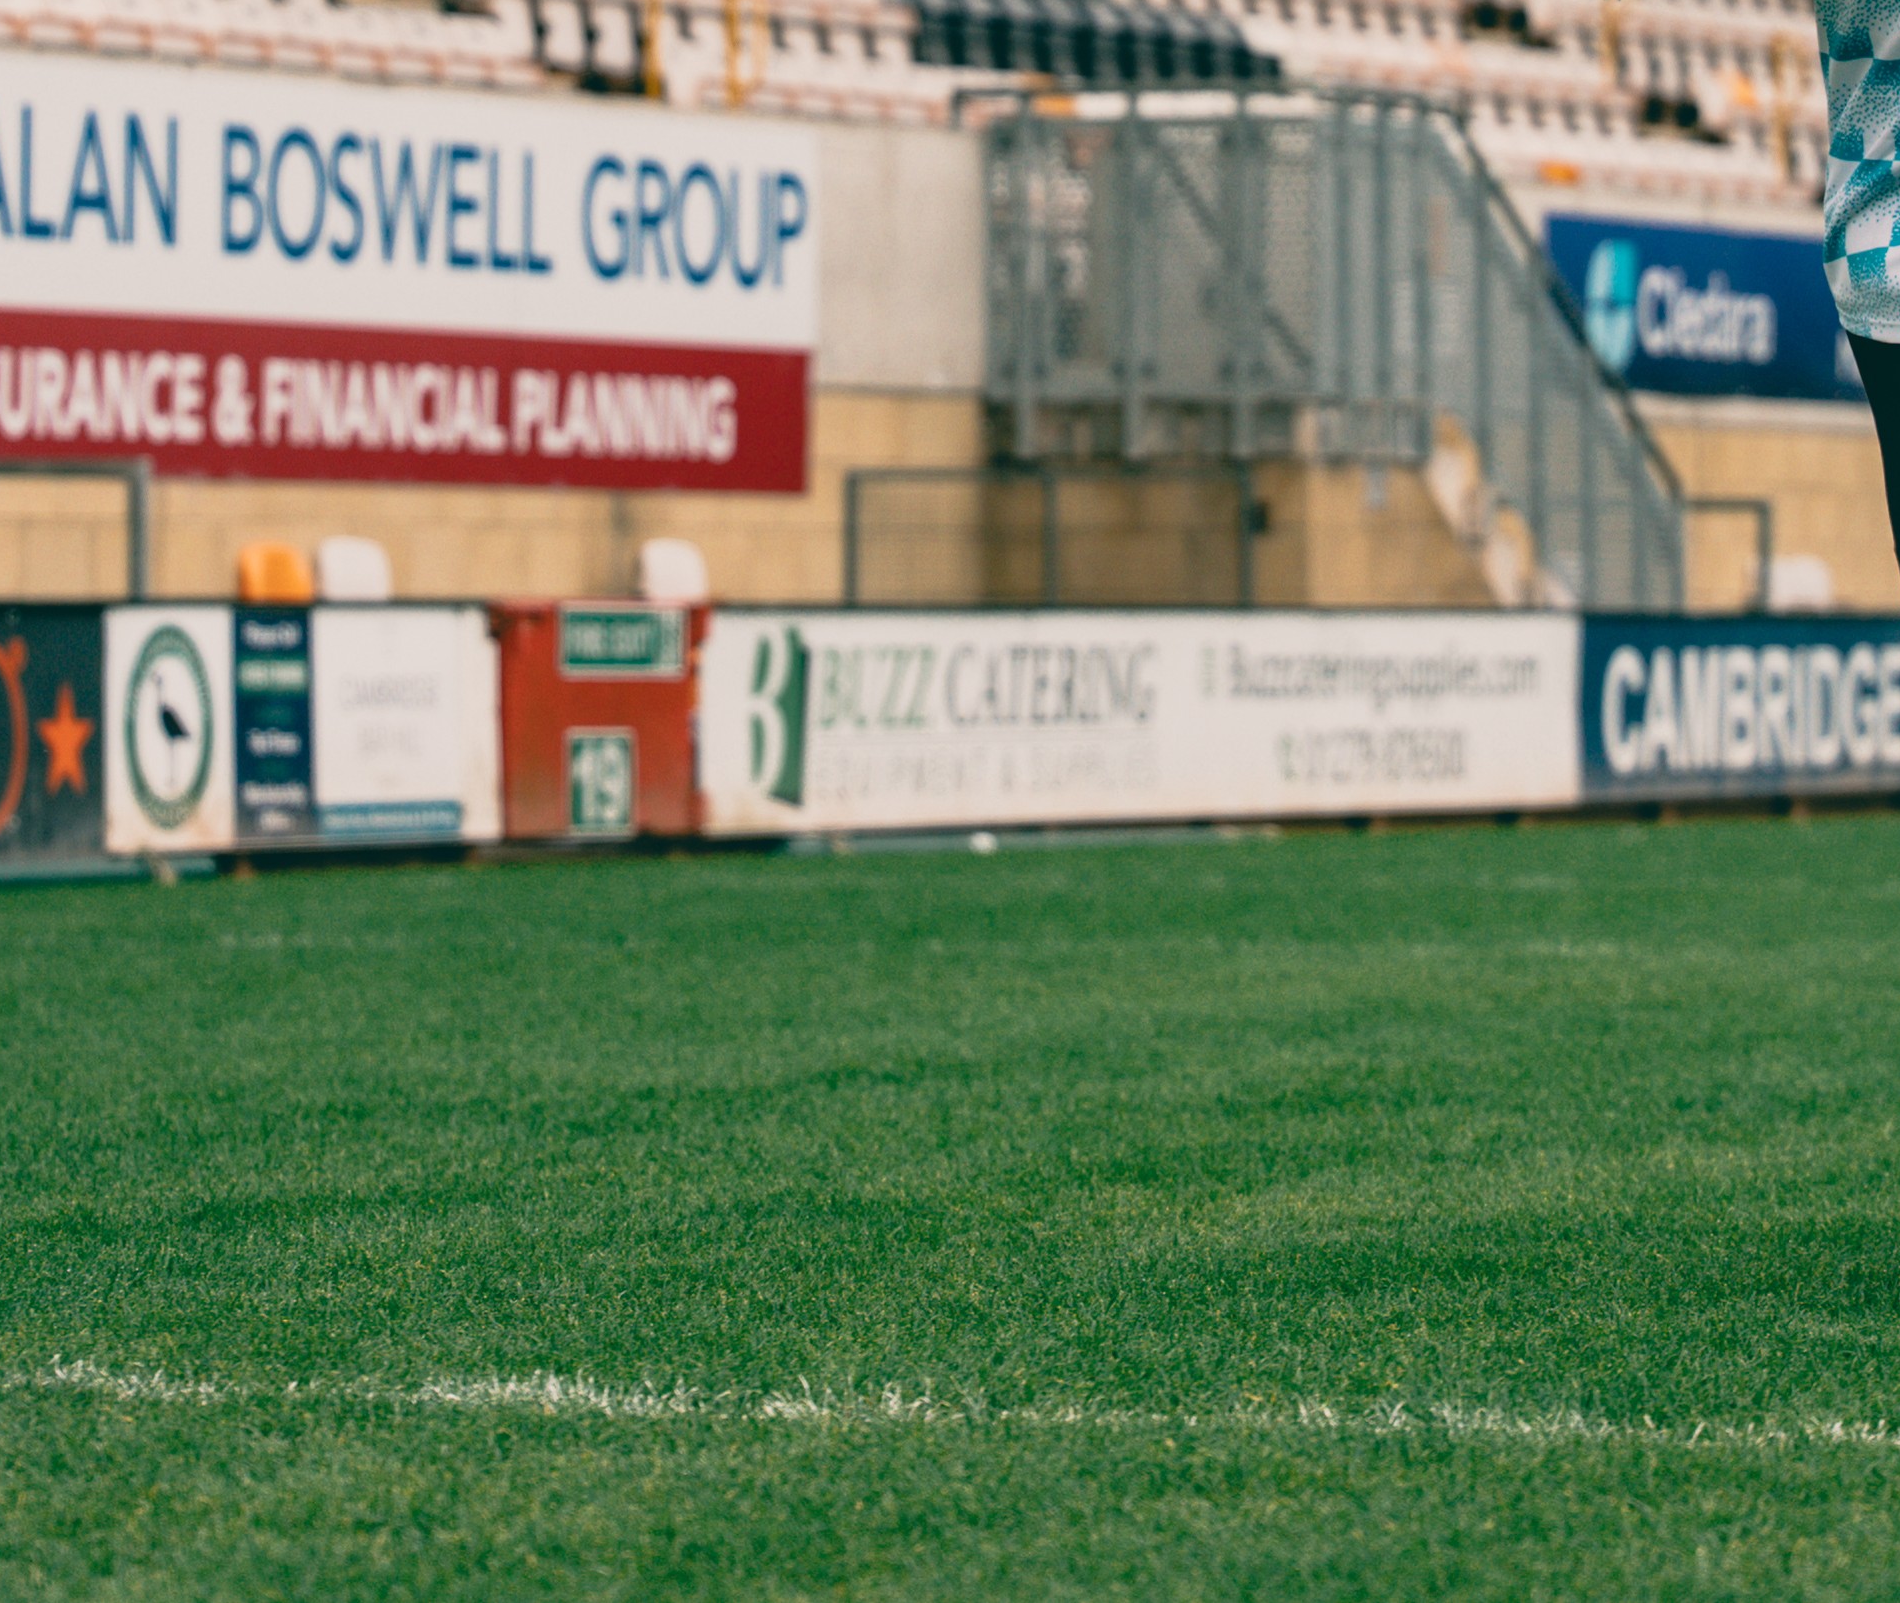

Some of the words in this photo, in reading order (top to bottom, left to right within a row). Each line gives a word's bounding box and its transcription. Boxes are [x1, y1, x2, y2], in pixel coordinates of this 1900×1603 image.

[220, 123, 554, 275] BOSWELL
[581, 152, 810, 290] GROUP
[210, 353, 256, 447] &
[261, 357, 507, 453] FINANCIAL
[513, 369, 738, 463] PLANNING
[818, 644, 936, 728] BUZZ
[945, 640, 1158, 725] CATERING
